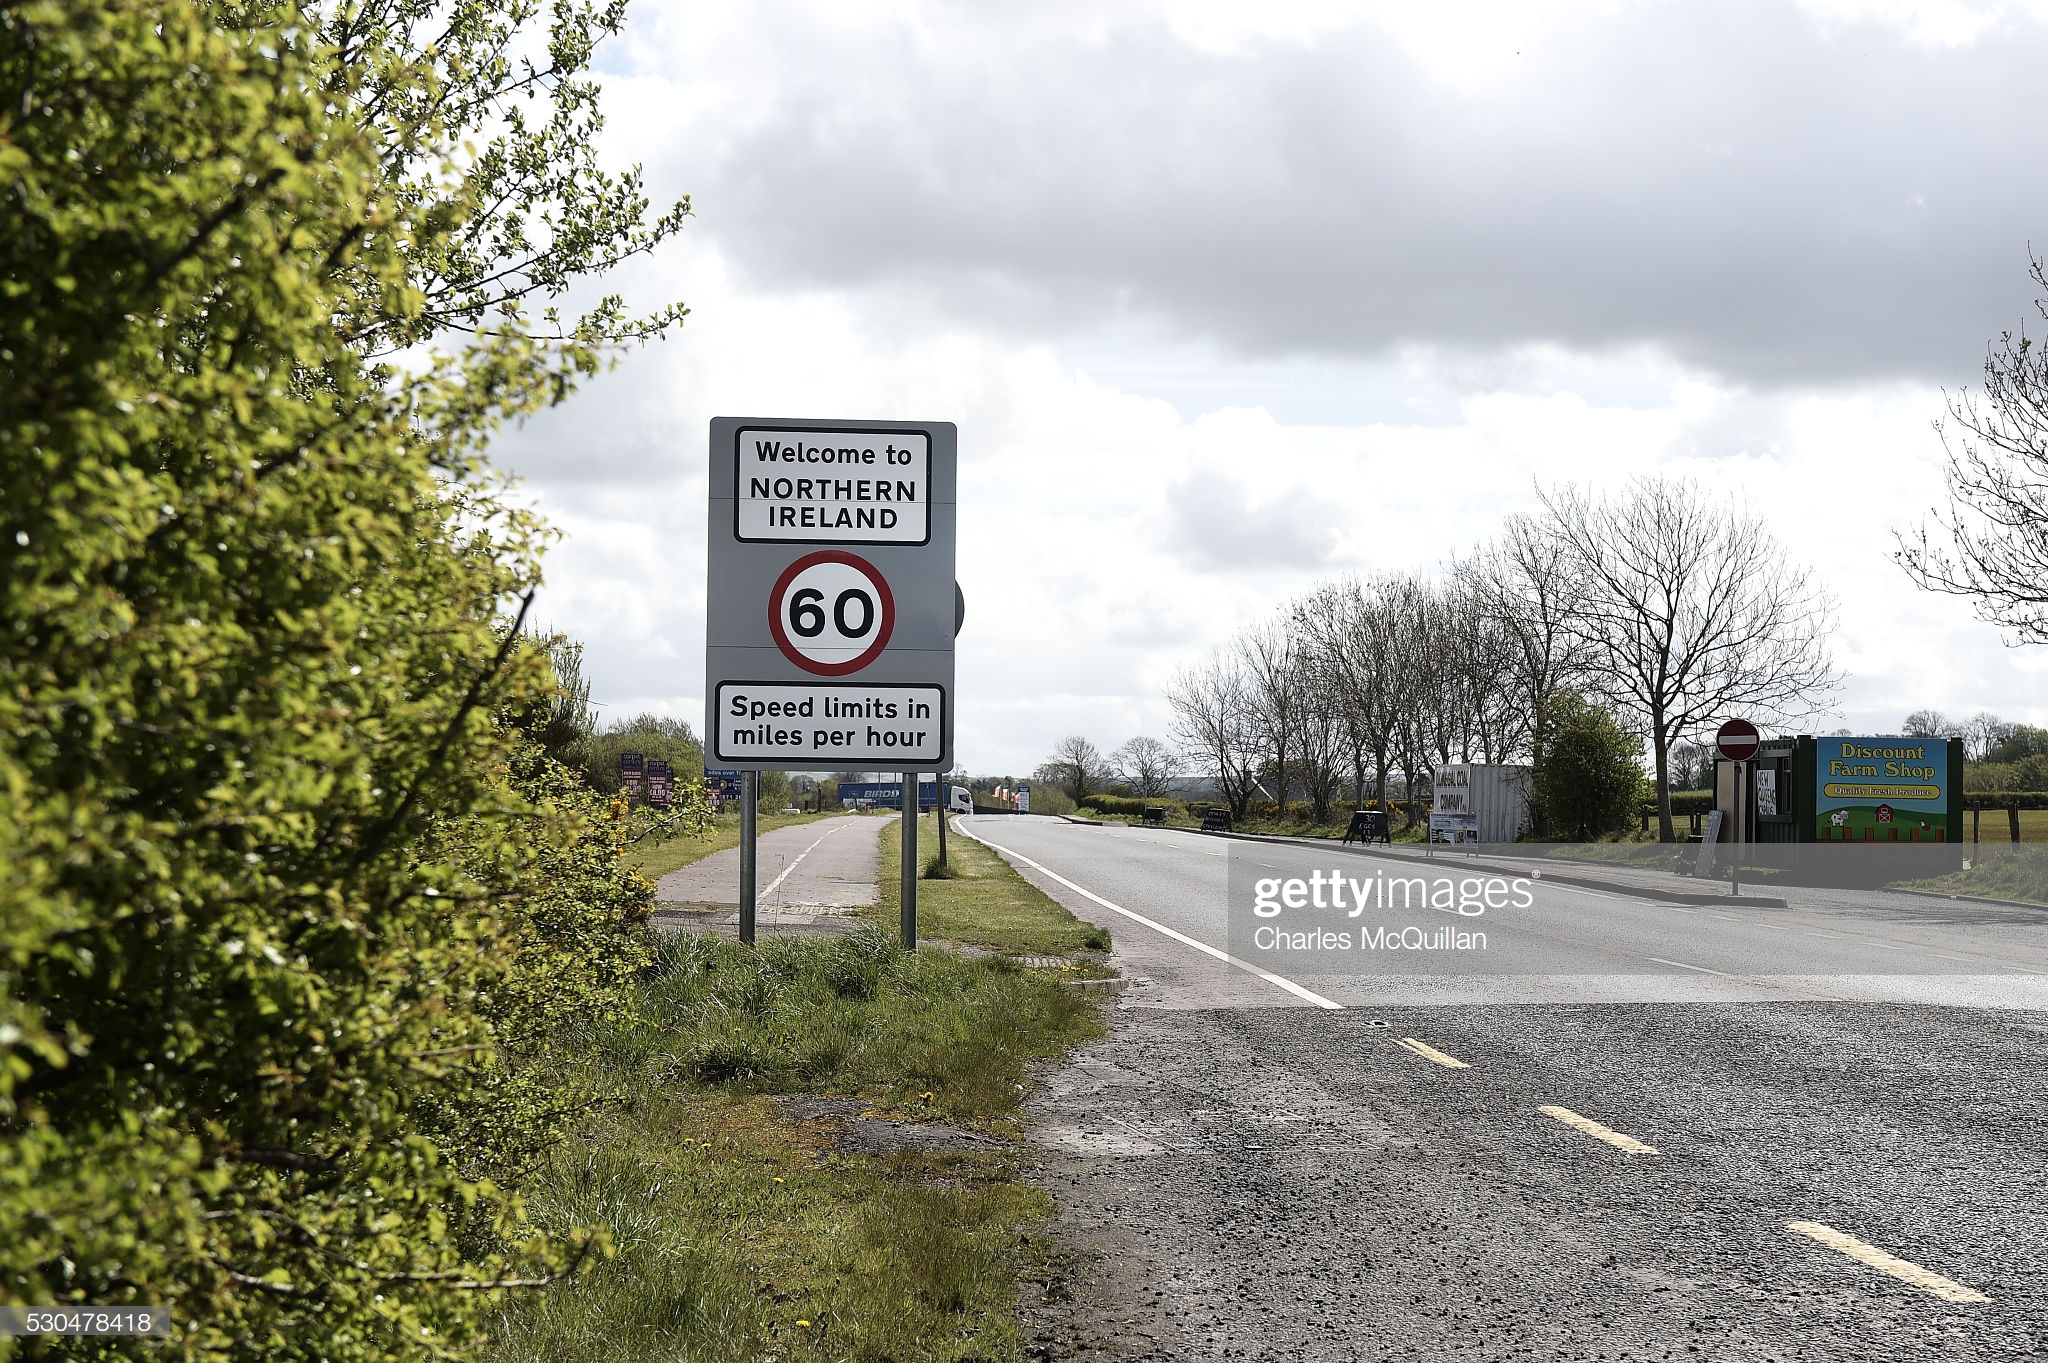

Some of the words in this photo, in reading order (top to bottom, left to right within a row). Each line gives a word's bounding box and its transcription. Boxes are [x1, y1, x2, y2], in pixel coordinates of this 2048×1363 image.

[755, 441, 876, 464] Welcome
[886, 444, 912, 465] to
[750, 477, 915, 502] NORTHERN
[769, 506, 898, 529] IRELAND
[789, 588, 875, 639] 60
[730, 695, 814, 721] Speed
[824, 697, 898, 719] limits
[908, 698, 930, 719] in
[733, 724, 803, 746] miles
[813, 730, 856, 750] per
[867, 726, 926, 747] hour
[1841, 743, 1925, 759] Discount
[1457, 770, 1468, 787] COAL
[1758, 771, 1769, 788] NEW
[1829, 760, 1879, 777] Farm
[1884, 761, 1935, 780] Shop
[1834, 787, 1866, 796] Quality
[1869, 787, 1893, 795] Fresh
[1896, 788, 1931, 796] Produce
[1440, 794, 1463, 811] COMPANY
[1365, 814, 1376, 823] 30
